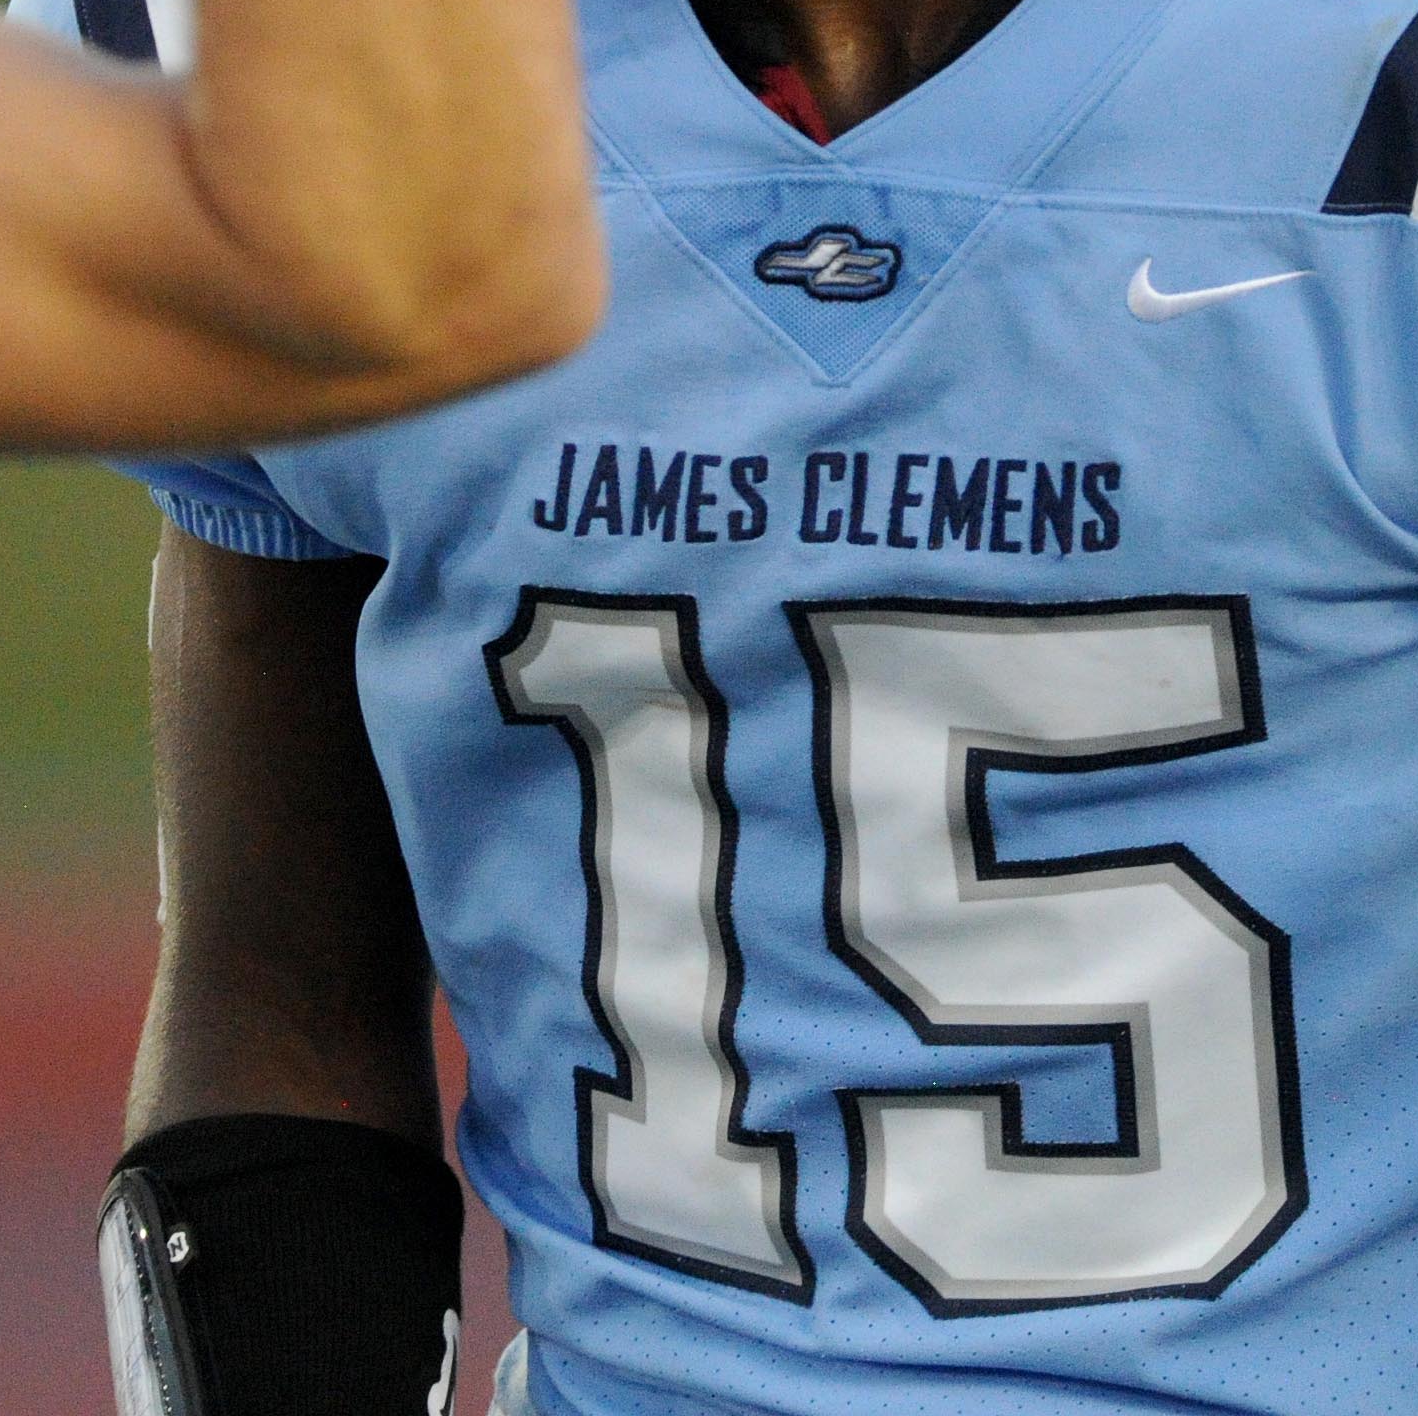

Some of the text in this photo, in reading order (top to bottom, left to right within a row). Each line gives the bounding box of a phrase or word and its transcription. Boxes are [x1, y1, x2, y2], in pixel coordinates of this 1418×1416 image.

[534, 442, 1121, 554] JAMES CLEMENS
[482, 584, 1309, 1320] 15
